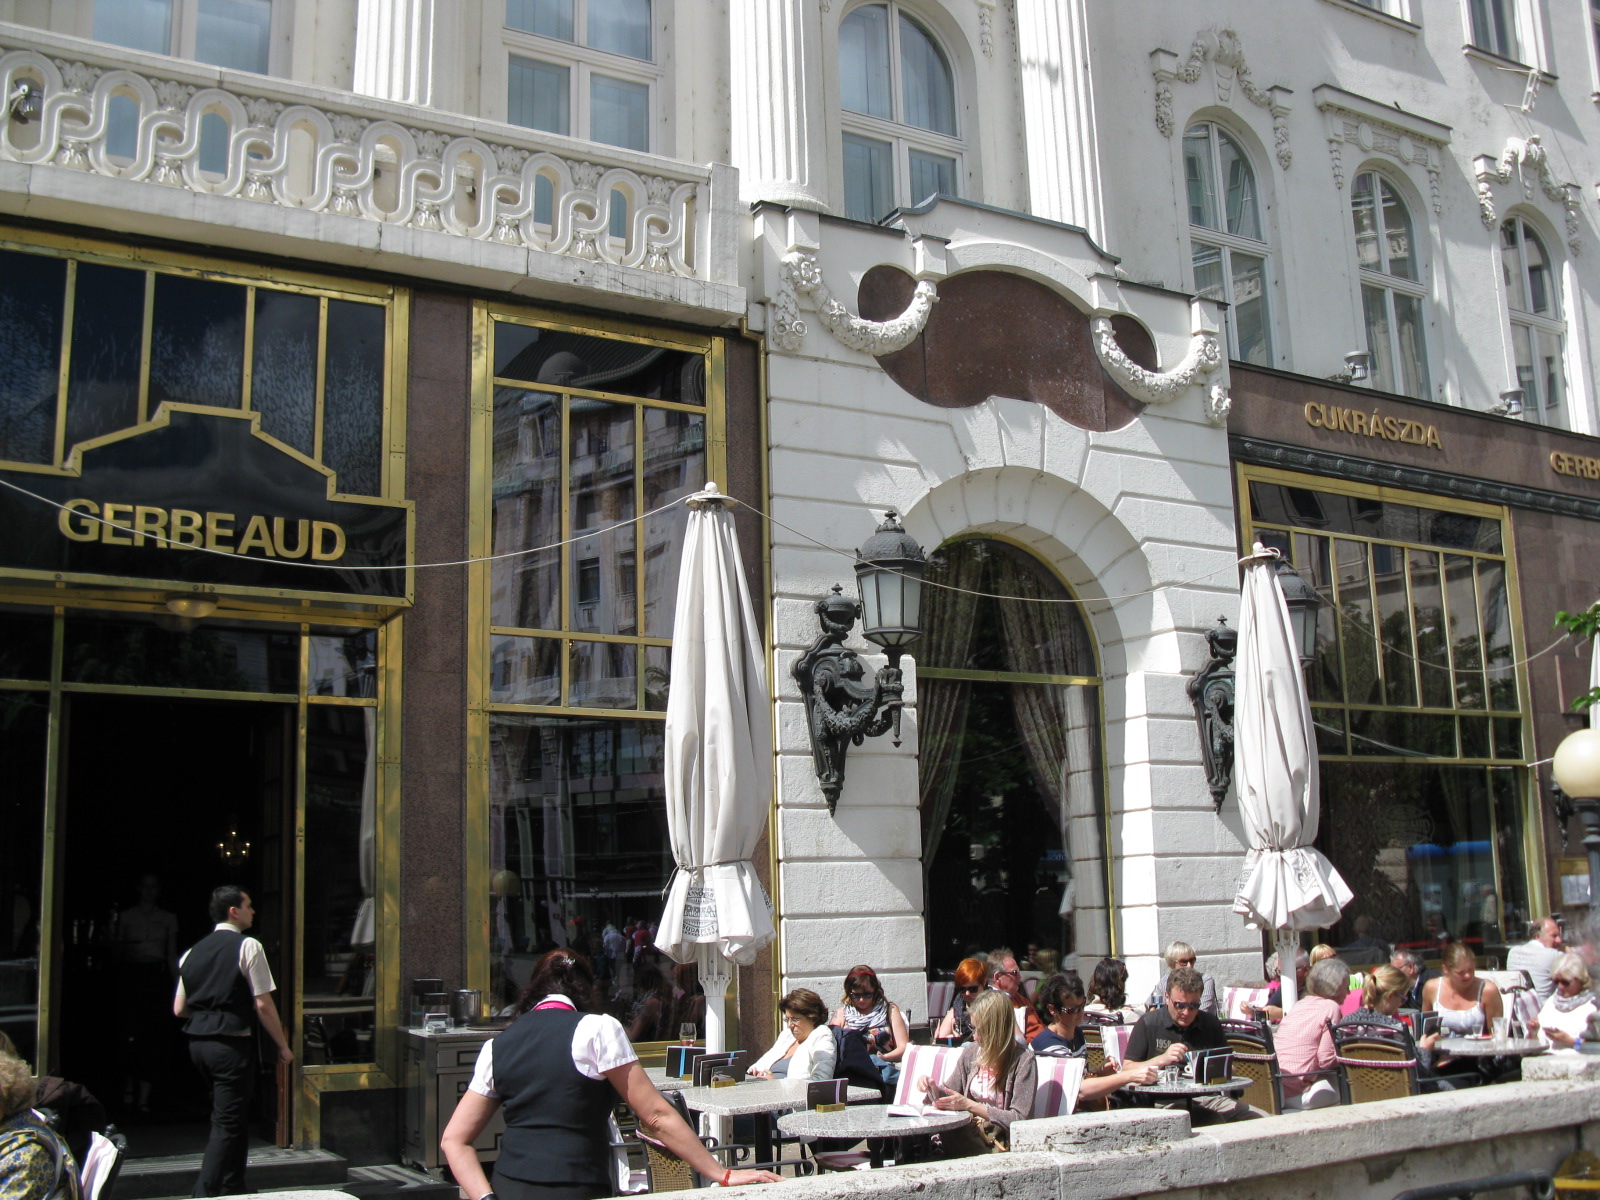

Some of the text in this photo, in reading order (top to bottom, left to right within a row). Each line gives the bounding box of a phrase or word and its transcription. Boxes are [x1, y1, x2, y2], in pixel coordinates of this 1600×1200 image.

[1304, 401, 1442, 450] CUKRÁSZDA
[1550, 451, 1600, 480] GERB
[58, 499, 346, 561] GERBEAUD
